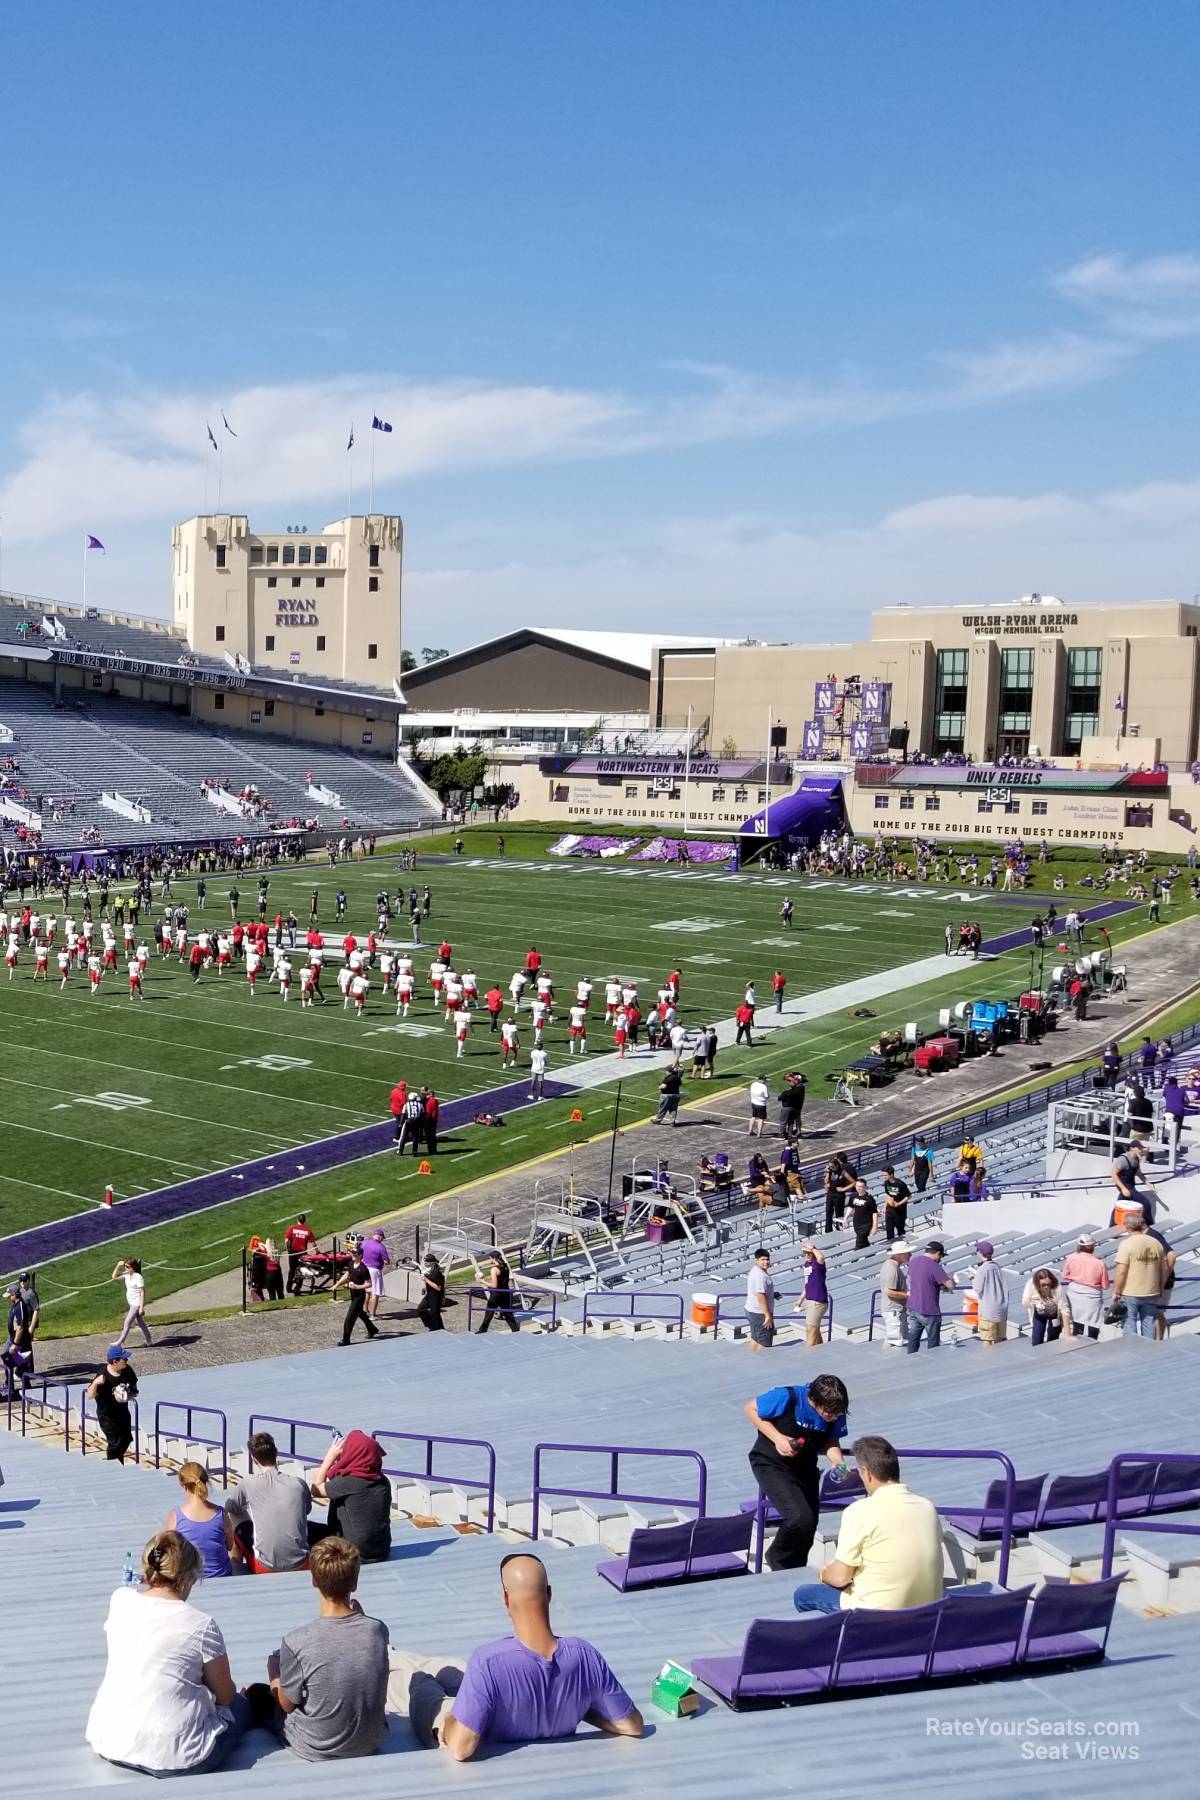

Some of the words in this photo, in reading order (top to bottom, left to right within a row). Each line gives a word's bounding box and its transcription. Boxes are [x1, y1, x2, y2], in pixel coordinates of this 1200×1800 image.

[277, 598, 316, 612] RYAN
[274, 613, 319, 627] FIELD
[962, 614, 1036, 627] WELSH-RYAN
[1039, 613, 1078, 626] ARENA
[1003, 626, 1042, 635] MEMORIAL
[1044, 625, 1064, 634] HALL
[58, 652, 76, 664] 1903
[82, 655, 100, 667] 1926
[106, 658, 124, 670] 1930
[130, 661, 147, 673] 1931
[152, 665, 171, 677] 1936
[177, 667, 196, 680] 1995
[201, 671, 219, 684] 1996
[225, 674, 246, 688] 2000
[818, 690, 832, 708] N
[865, 690, 879, 709] N
[807, 729, 820, 747] N
[854, 730, 868, 748] N
[597, 760, 671, 773] NORTHWESTERN
[673, 762, 720, 775] WIDCATS
[656, 778, 670, 788] 25
[967, 771, 996, 784] UNLV
[998, 771, 1043, 785] REBELS
[569, 807, 591, 815] HOME
[594, 808, 604, 816] OF
[607, 808, 624, 817] THE
[627, 809, 647, 818] 2018
[650, 810, 665, 819] BIG
[669, 811, 685, 820] TEN
[689, 811, 714, 821] WEST
[754, 819, 765, 833] N
[873, 820, 899, 830] HOME
[904, 821, 917, 831] OF
[921, 822, 941, 831] THE
[945, 823, 970, 833] 2018
[974, 824, 992, 834] BIG
[997, 825, 1017, 835] TEN
[1022, 827, 1053, 837] WEST
[1058, 828, 1124, 841] CHAMPIONS
[451, 859, 998, 903] NORTHWESTERN
[237, 1054, 314, 1072] 20
[71, 1091, 153, 1111] 10
[420, 1163, 430, 1173] 10
